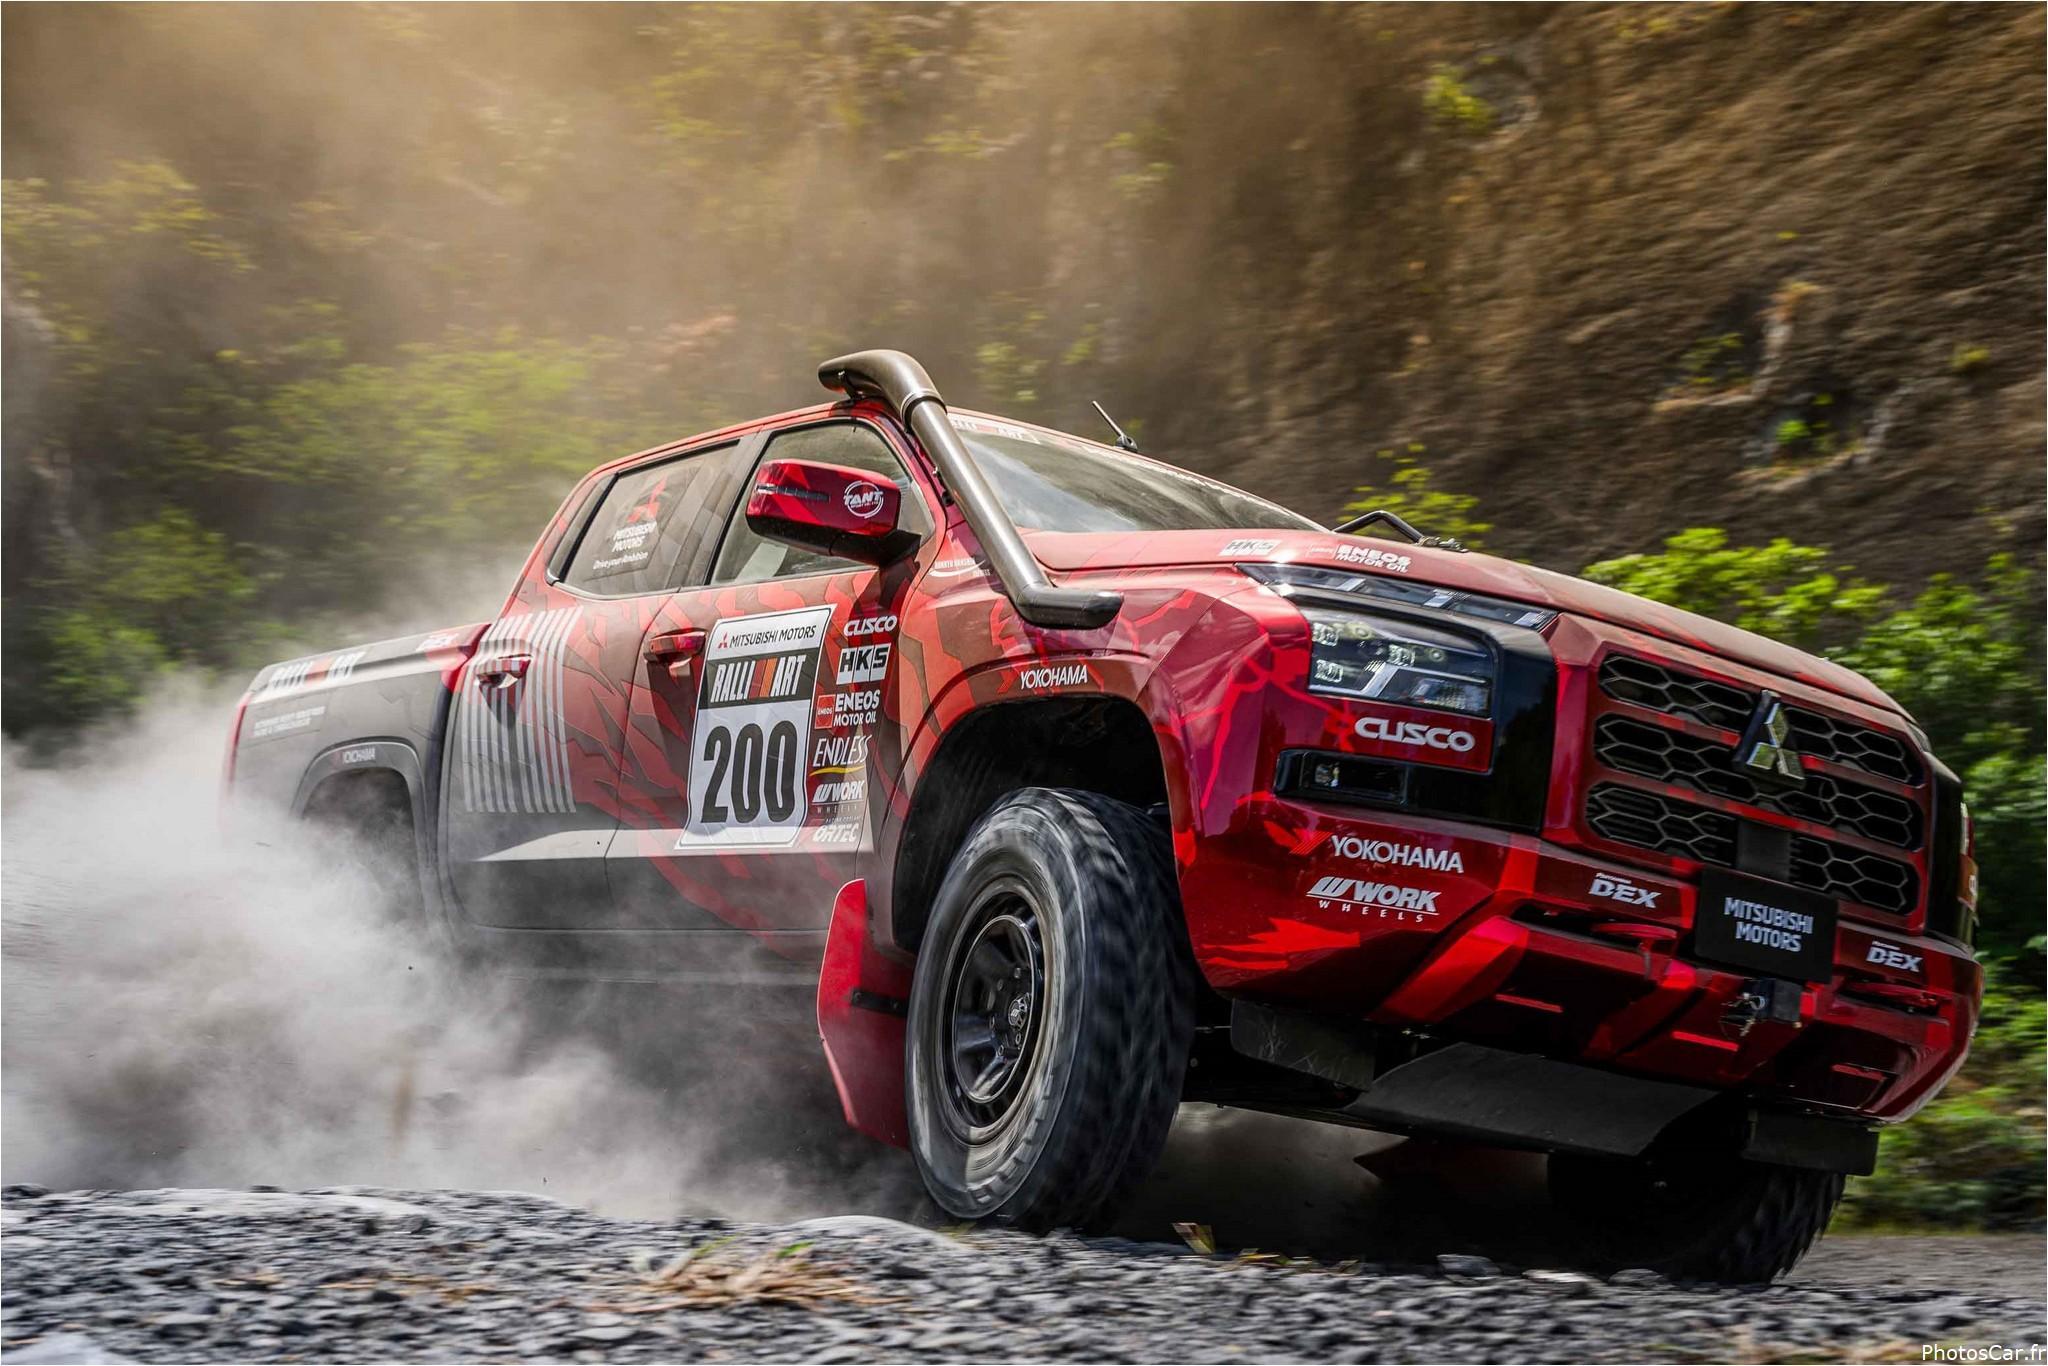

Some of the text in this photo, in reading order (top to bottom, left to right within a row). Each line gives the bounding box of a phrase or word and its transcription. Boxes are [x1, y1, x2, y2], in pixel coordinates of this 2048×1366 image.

[843, 491, 883, 506] TANT
[612, 536, 646, 552] MOTORS
[1338, 544, 1412, 566] ENEOS
[1335, 553, 1409, 573] MOTOR OIL
[729, 625, 816, 648] MITSUBISHI MOTORS
[844, 615, 898, 636] CUSCO
[838, 645, 890, 674] HKS
[1020, 664, 1088, 690] YOKOHAMA
[835, 690, 880, 712] ENEOS
[833, 711, 877, 727] MOTOR OIL
[1354, 717, 1476, 752] CUSCO
[813, 734, 872, 767] ENDLESS
[701, 721, 797, 823] 200
[1331, 835, 1464, 873] YOKOHAMA
[1588, 879, 1662, 908] DEX
[1319, 900, 1424, 922] WHEELS
[1724, 897, 1814, 934] MITSUBISHI
[1735, 921, 1802, 952] MOTORS
[1866, 946, 1924, 972] DEX
